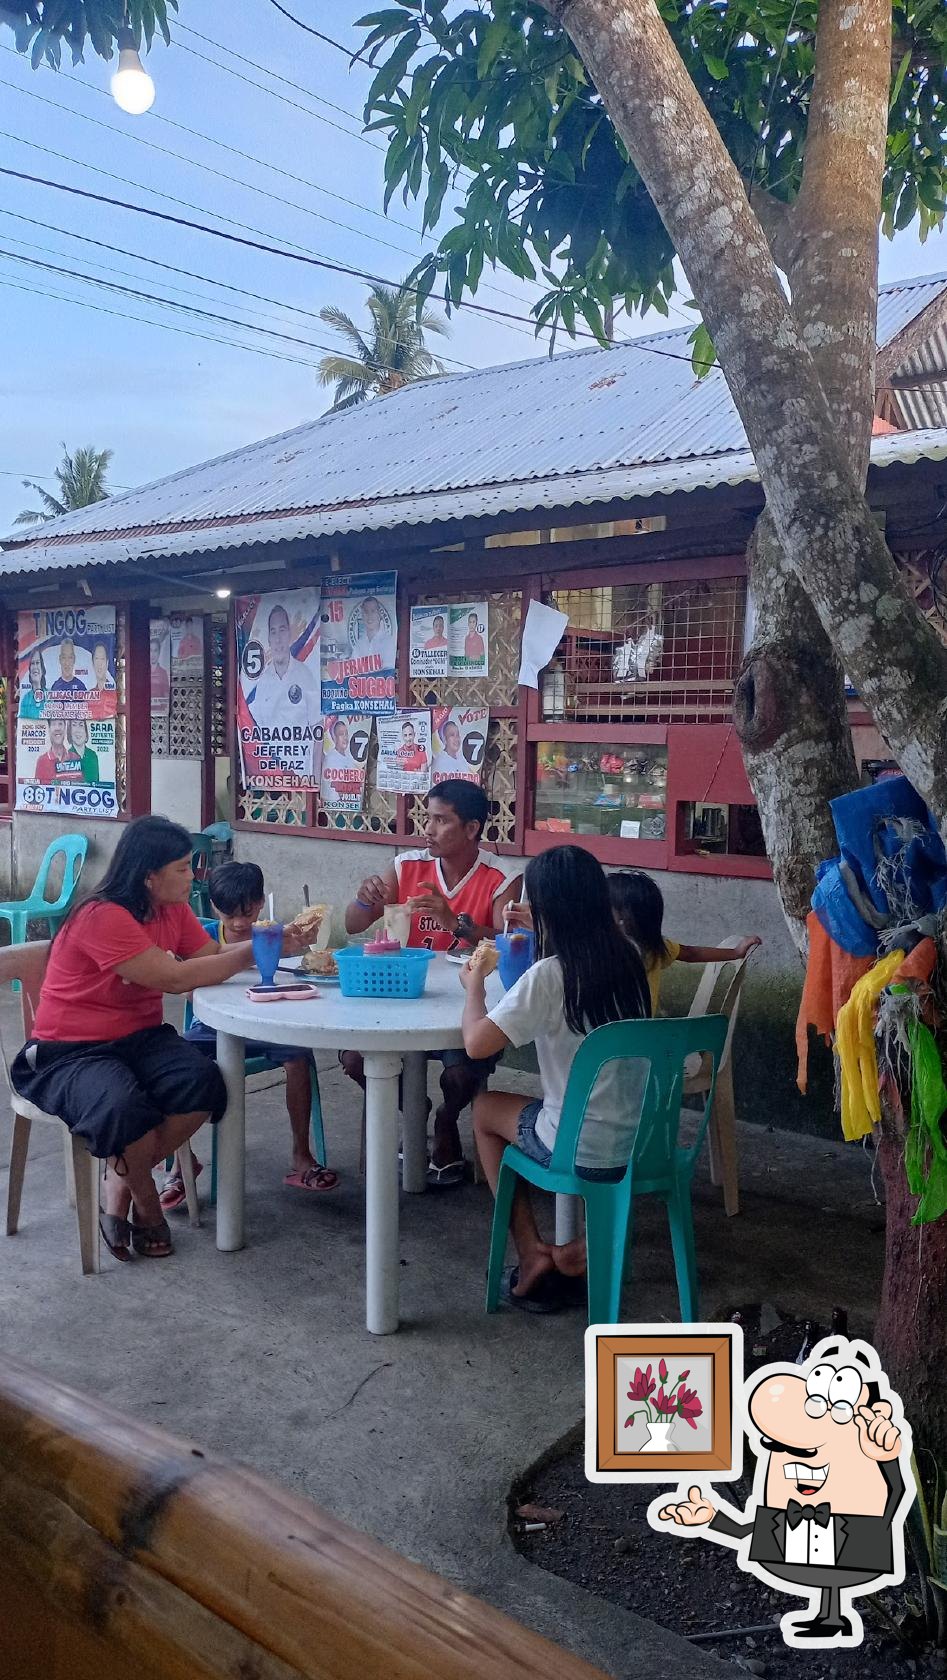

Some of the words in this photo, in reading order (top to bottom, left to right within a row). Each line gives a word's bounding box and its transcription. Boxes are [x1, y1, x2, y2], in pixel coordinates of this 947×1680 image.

[328, 600, 344, 622] 15
[246, 649, 262, 674] 5
[335, 654, 383, 685] JERWIN
[348, 676, 396, 699] SUGBO
[331, 701, 353, 712] Pagka
[354, 700, 395, 711] KONSEHAL
[457, 707, 487, 726] VOTE
[90, 723, 114, 732] SARA
[241, 726, 324, 742] CABAOBAO
[253, 745, 309, 757] JEFFREY
[354, 737, 369, 759] 7
[467, 738, 484, 761] 7
[260, 760, 276, 770] DE
[280, 760, 305, 770] PAZ
[245, 775, 320, 787] KONSEHAL
[323, 767, 366, 782] COCHERO
[24, 786, 45, 804] 86
[71, 805, 98, 813] PARTY
